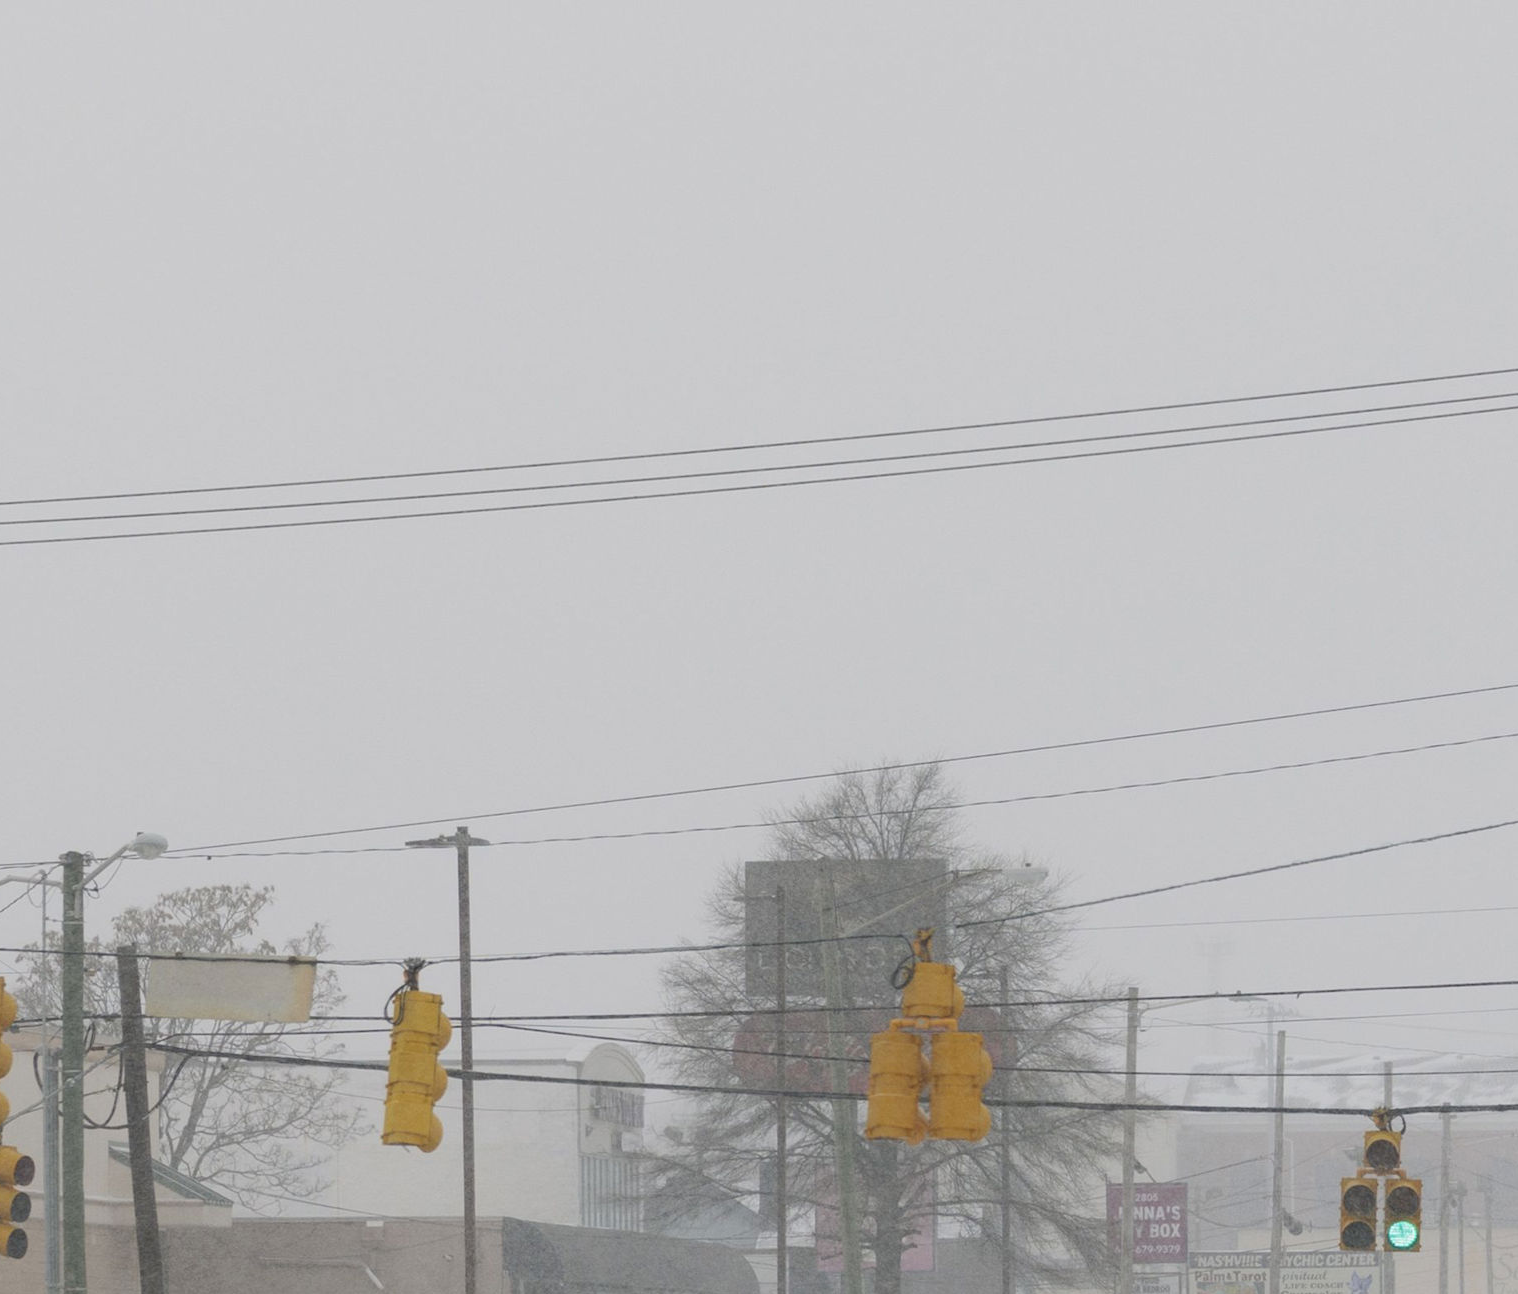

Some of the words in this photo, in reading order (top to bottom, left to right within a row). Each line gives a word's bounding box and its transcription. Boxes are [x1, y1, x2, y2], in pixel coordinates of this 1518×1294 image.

[1149, 1223, 1181, 1238] BOX
[1279, 1253, 1325, 1268] YCHIC
[1325, 1252, 1376, 1267] CENTER
[1281, 1270, 1329, 1284] piritual
